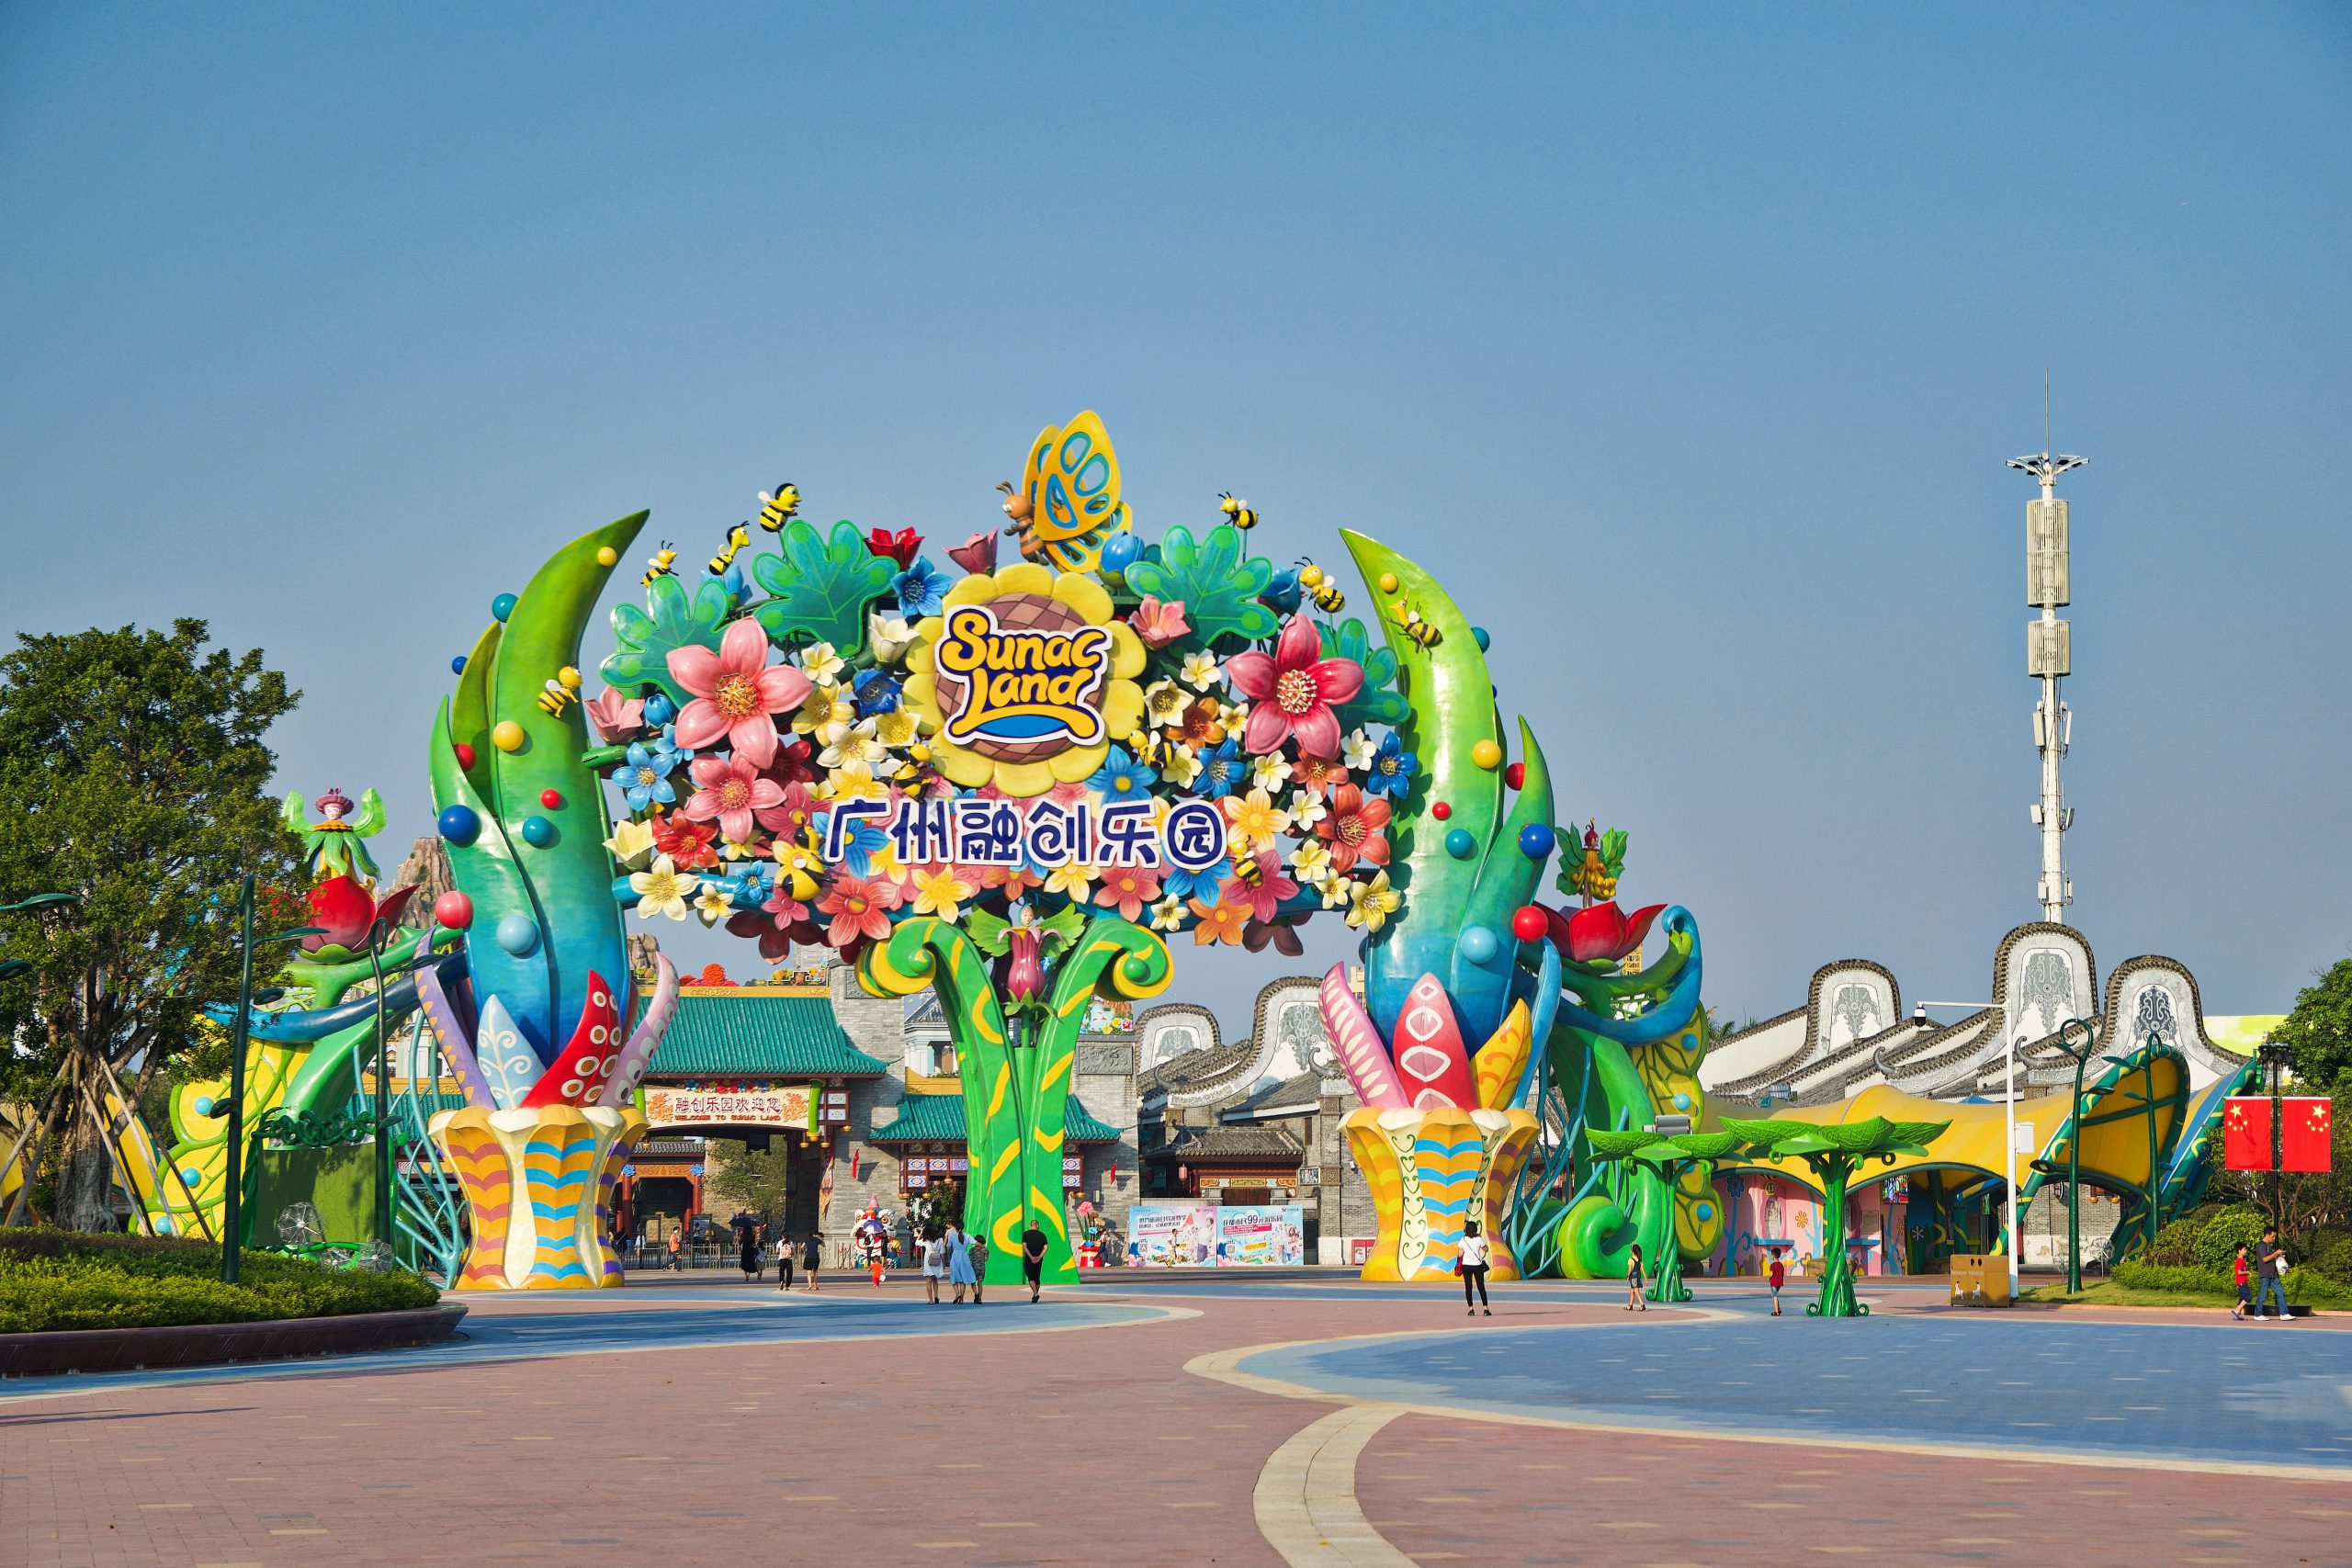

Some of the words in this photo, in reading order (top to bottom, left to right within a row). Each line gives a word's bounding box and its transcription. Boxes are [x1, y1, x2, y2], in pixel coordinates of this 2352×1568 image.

[940, 607, 1109, 673] Sunac
[949, 667, 1101, 739] Land
[825, 798, 1228, 868] 广州融创乐园
[674, 1097, 782, 1113] 融创乐园欢迎您
